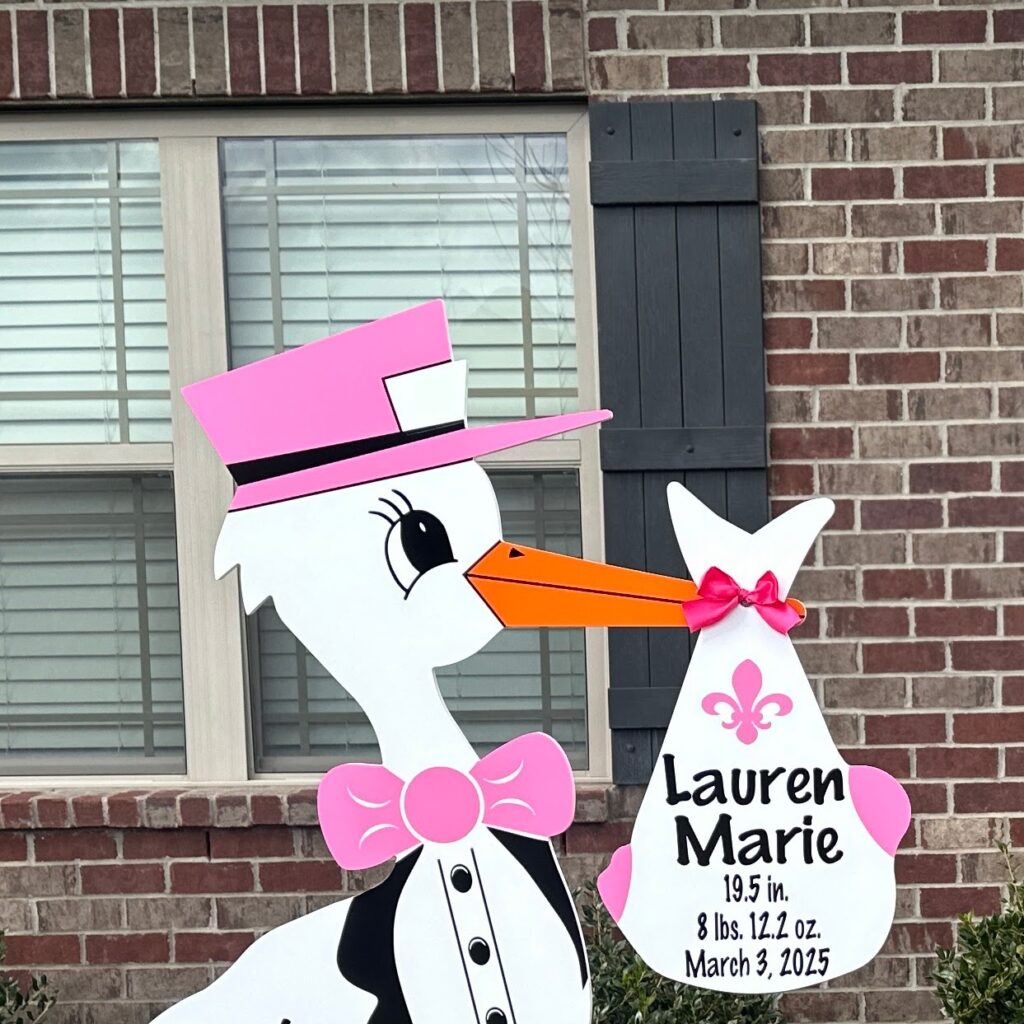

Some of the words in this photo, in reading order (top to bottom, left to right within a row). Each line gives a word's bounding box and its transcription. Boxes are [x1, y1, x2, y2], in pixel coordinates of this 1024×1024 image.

[662, 753, 845, 807] Lauren
[674, 812, 844, 867] Marie
[723, 873, 761, 903] 19.5
[767, 875, 789, 903] in.
[697, 911, 708, 941] 8
[714, 911, 743, 941] lbs.
[749, 910, 789, 941] 12.2
[794, 919, 821, 940] oz.
[685, 947, 750, 979] March
[756, 948, 773, 980] 3,
[779, 947, 830, 977] 2025
